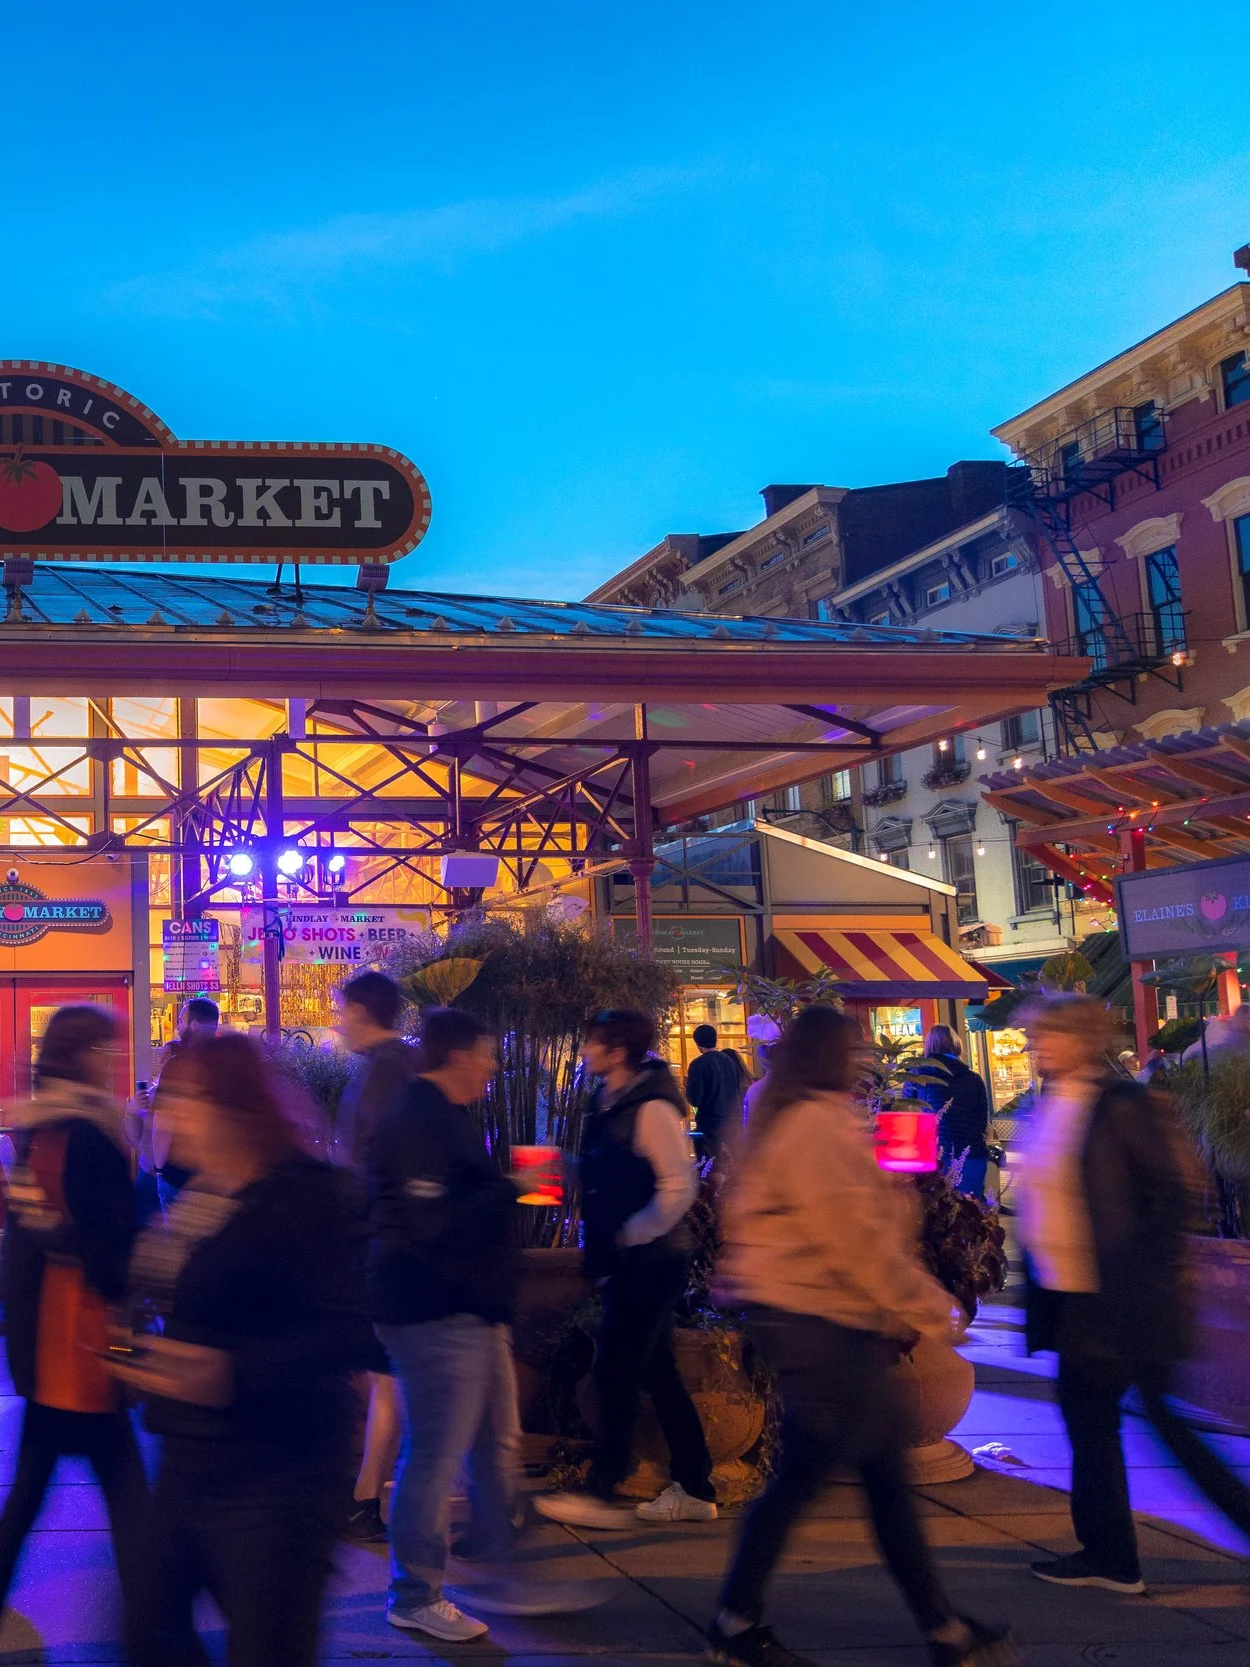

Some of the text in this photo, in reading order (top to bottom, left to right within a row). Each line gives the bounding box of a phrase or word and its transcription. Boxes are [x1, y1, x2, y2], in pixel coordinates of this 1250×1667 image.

[55, 475, 391, 528] MARKET
[23, 905, 102, 919] MARKET
[340, 915, 386, 923] MARKET
[1133, 903, 1195, 922] ELAINE'S
[169, 921, 212, 934] CANS
[247, 927, 407, 942] JEO SHOTS BEER
[318, 946, 362, 960] WINE
[681, 946, 736, 954] Tuesday-Sunday
[186, 981, 209, 990] SHOTS
[209, 981, 219, 990] $3
